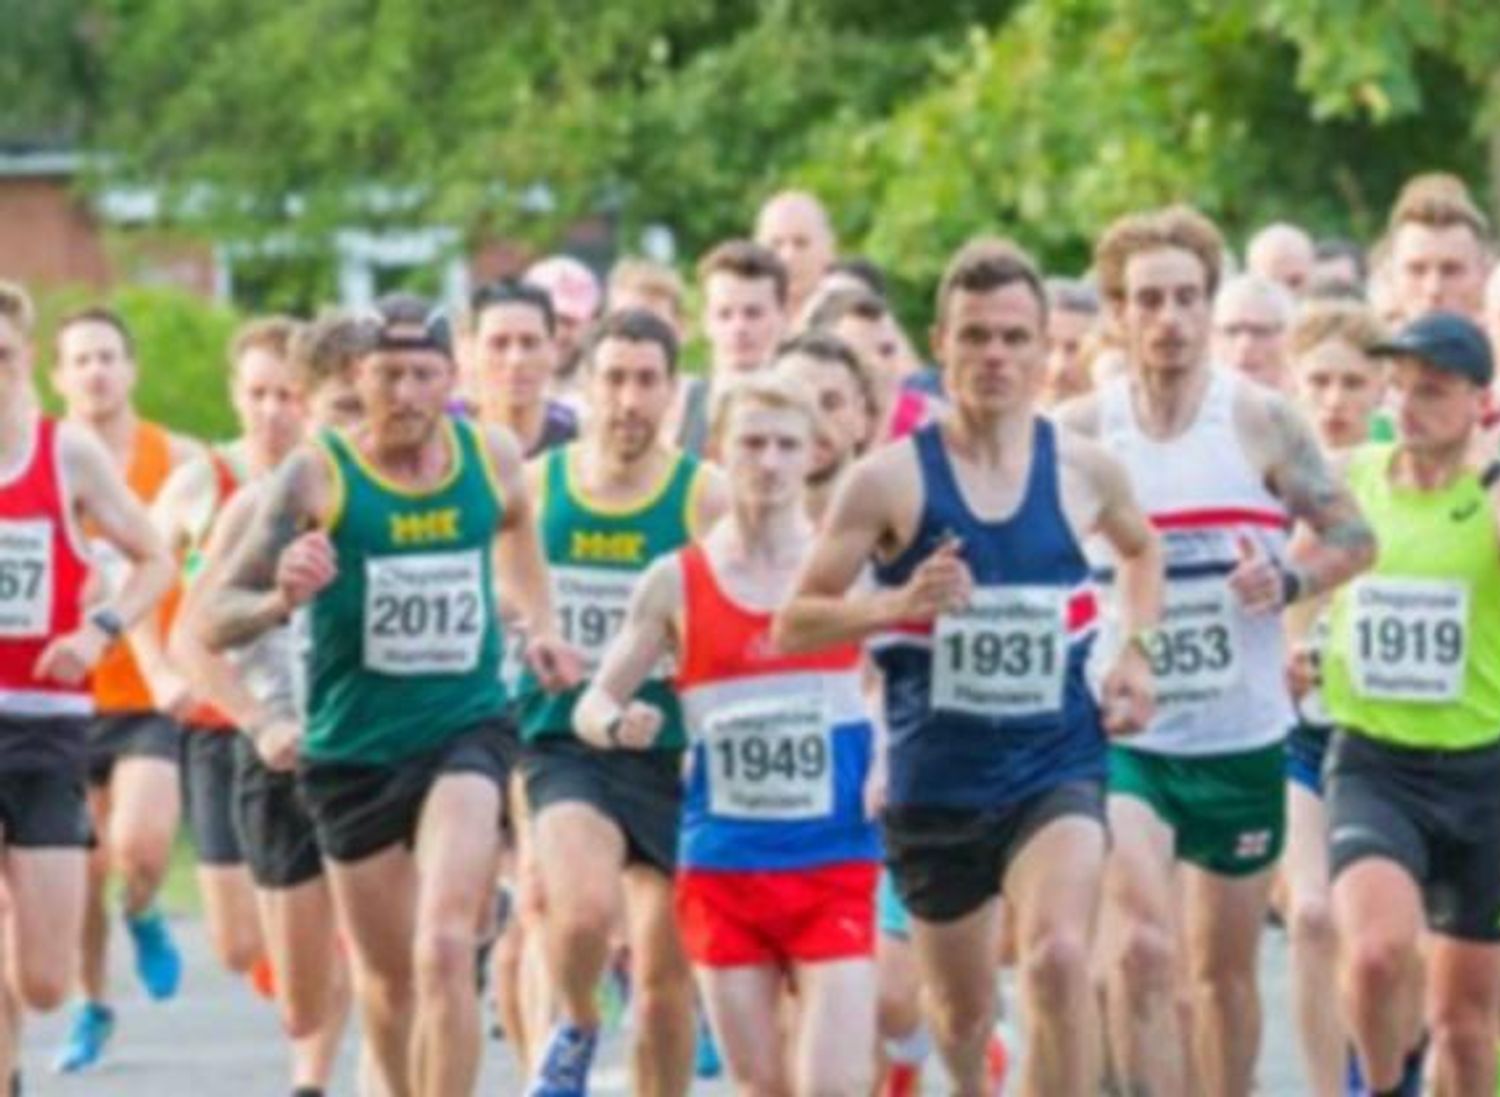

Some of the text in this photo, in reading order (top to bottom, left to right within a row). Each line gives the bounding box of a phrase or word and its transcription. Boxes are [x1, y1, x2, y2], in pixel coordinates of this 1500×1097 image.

[0, 558, 43, 601] 67
[372, 592, 479, 637] 2012
[559, 604, 629, 647] 197
[944, 629, 1055, 677] 1931
[1149, 622, 1234, 678] 953
[1356, 616, 1462, 667] 1919
[715, 732, 826, 783] 1949
